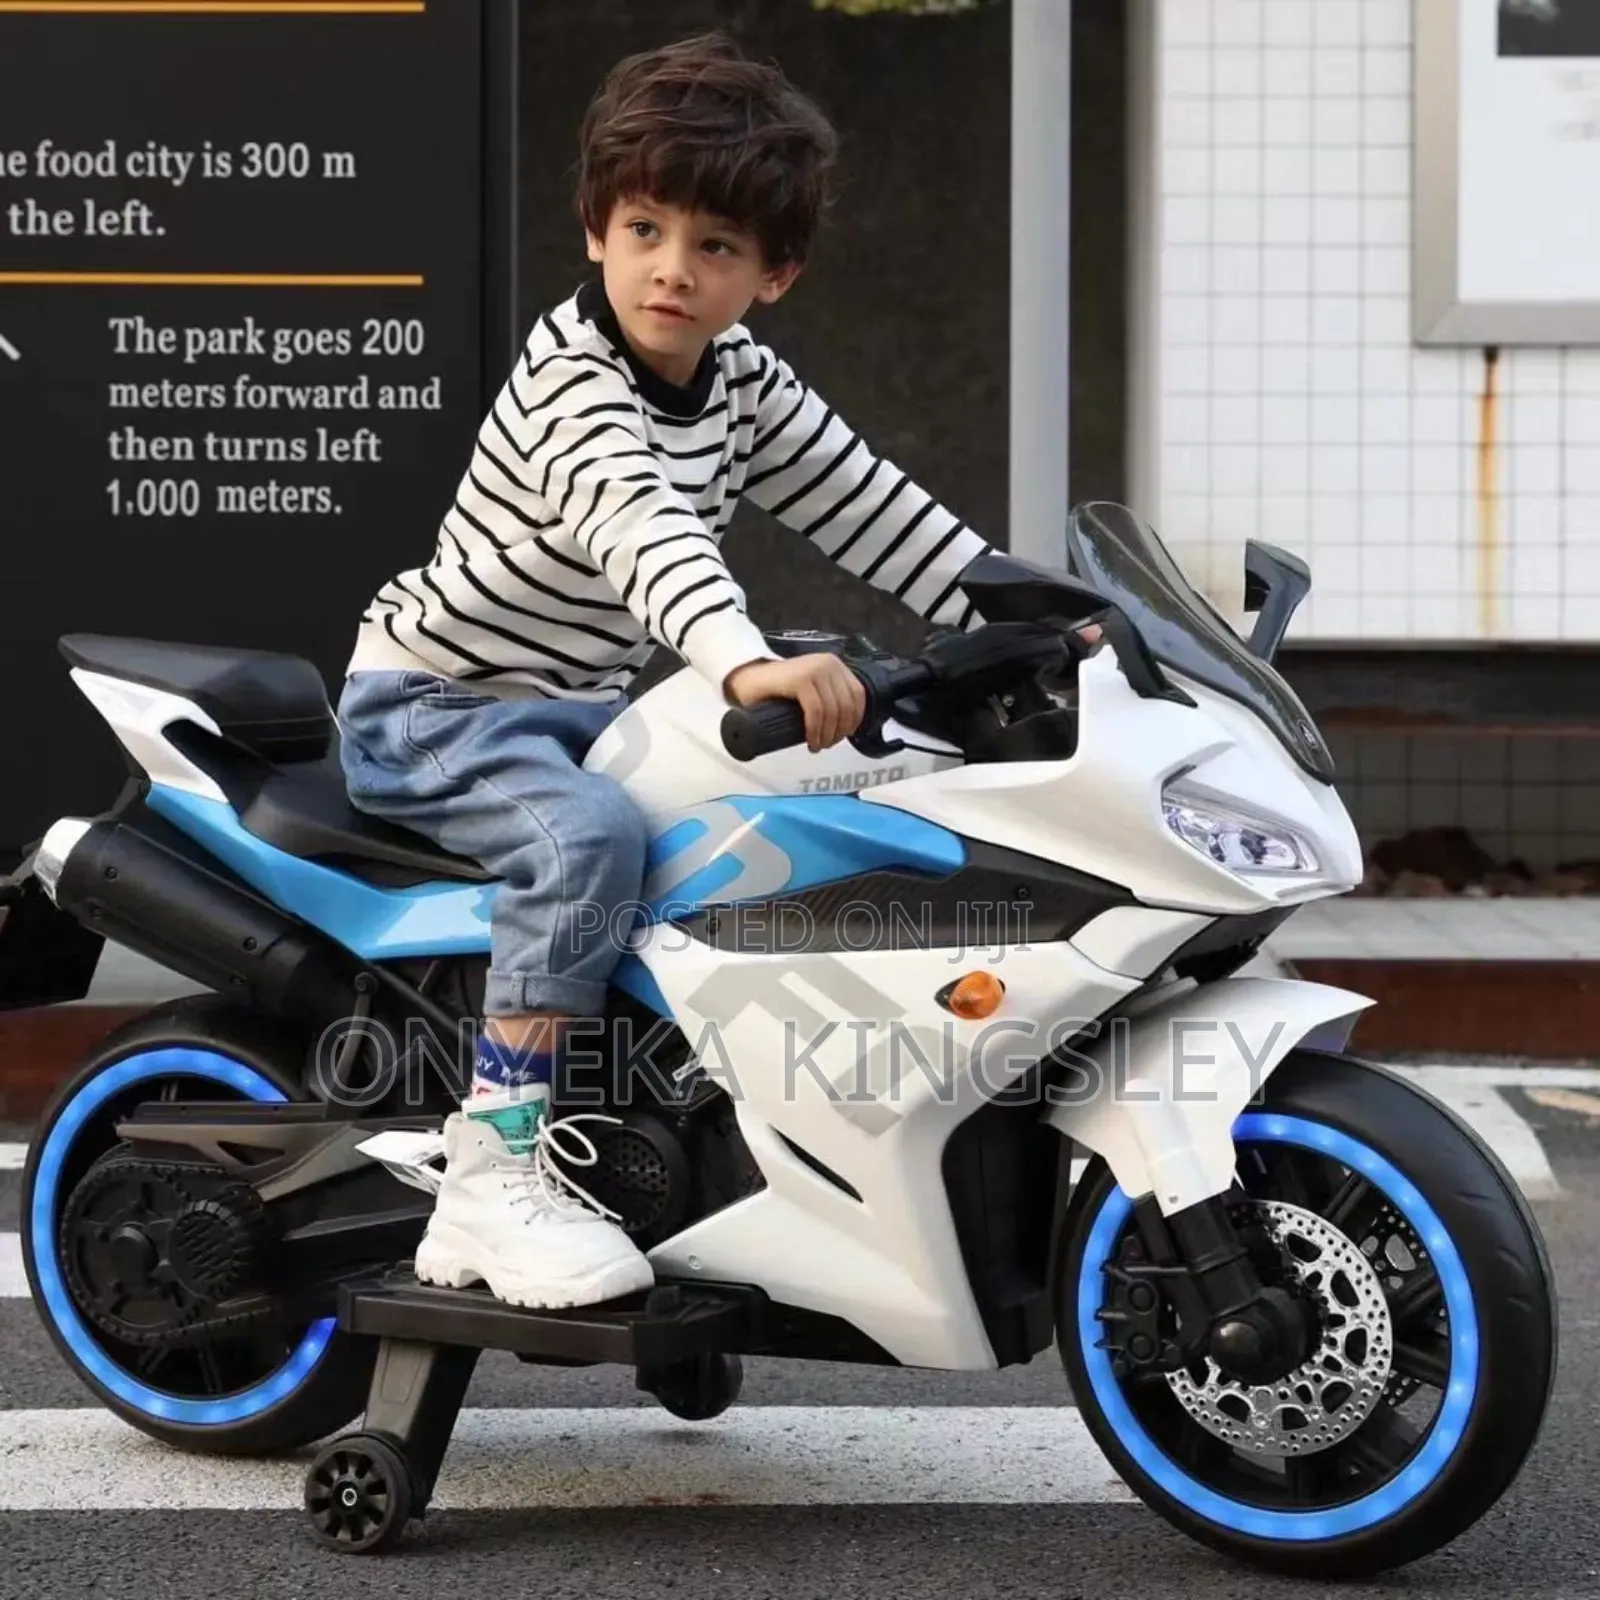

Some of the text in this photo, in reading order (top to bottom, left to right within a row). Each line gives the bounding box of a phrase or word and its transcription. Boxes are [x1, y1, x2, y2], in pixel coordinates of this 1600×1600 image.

[36, 139, 118, 178] food
[126, 141, 194, 187] city
[202, 141, 232, 178] is
[241, 141, 310, 178] 300
[323, 152, 356, 178] m
[8, 198, 166, 236] the left.
[109, 316, 424, 365] The park goes 200
[109, 374, 442, 410] meters forward and
[108, 426, 382, 462] then turns left
[216, 479, 342, 515] meters.
